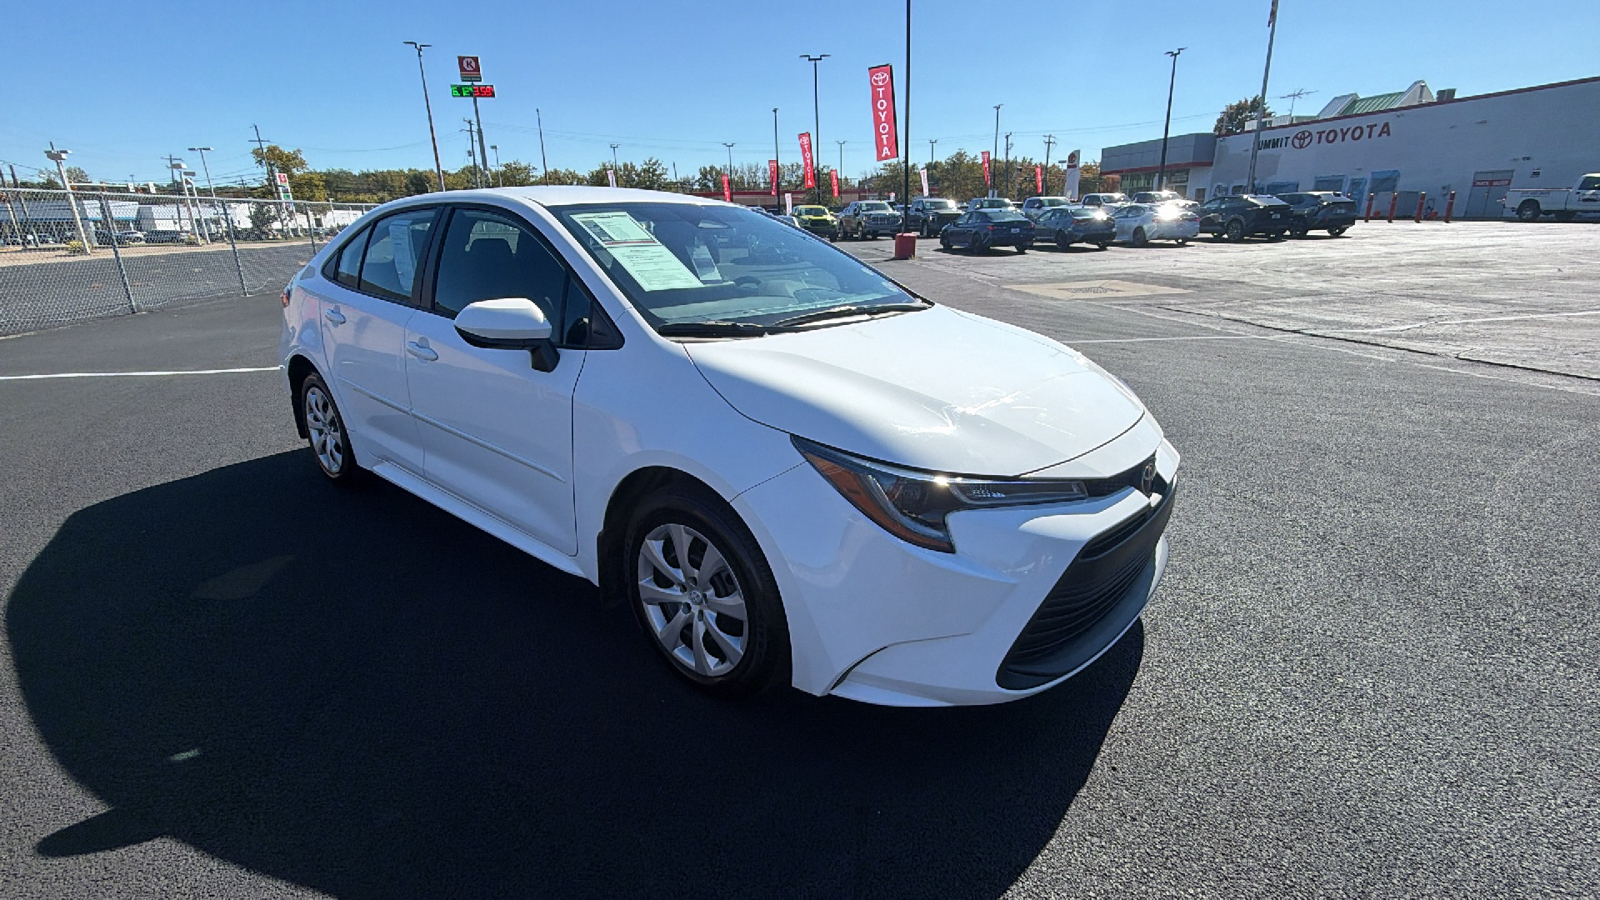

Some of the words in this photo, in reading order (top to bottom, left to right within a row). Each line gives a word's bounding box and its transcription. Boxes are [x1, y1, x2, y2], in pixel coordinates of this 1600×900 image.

[877, 87, 891, 157] TOYOTA
[1254, 136, 1290, 151] UMMIT
[1316, 122, 1391, 145] TOYOTA
[804, 145, 813, 186] TOYOTA
